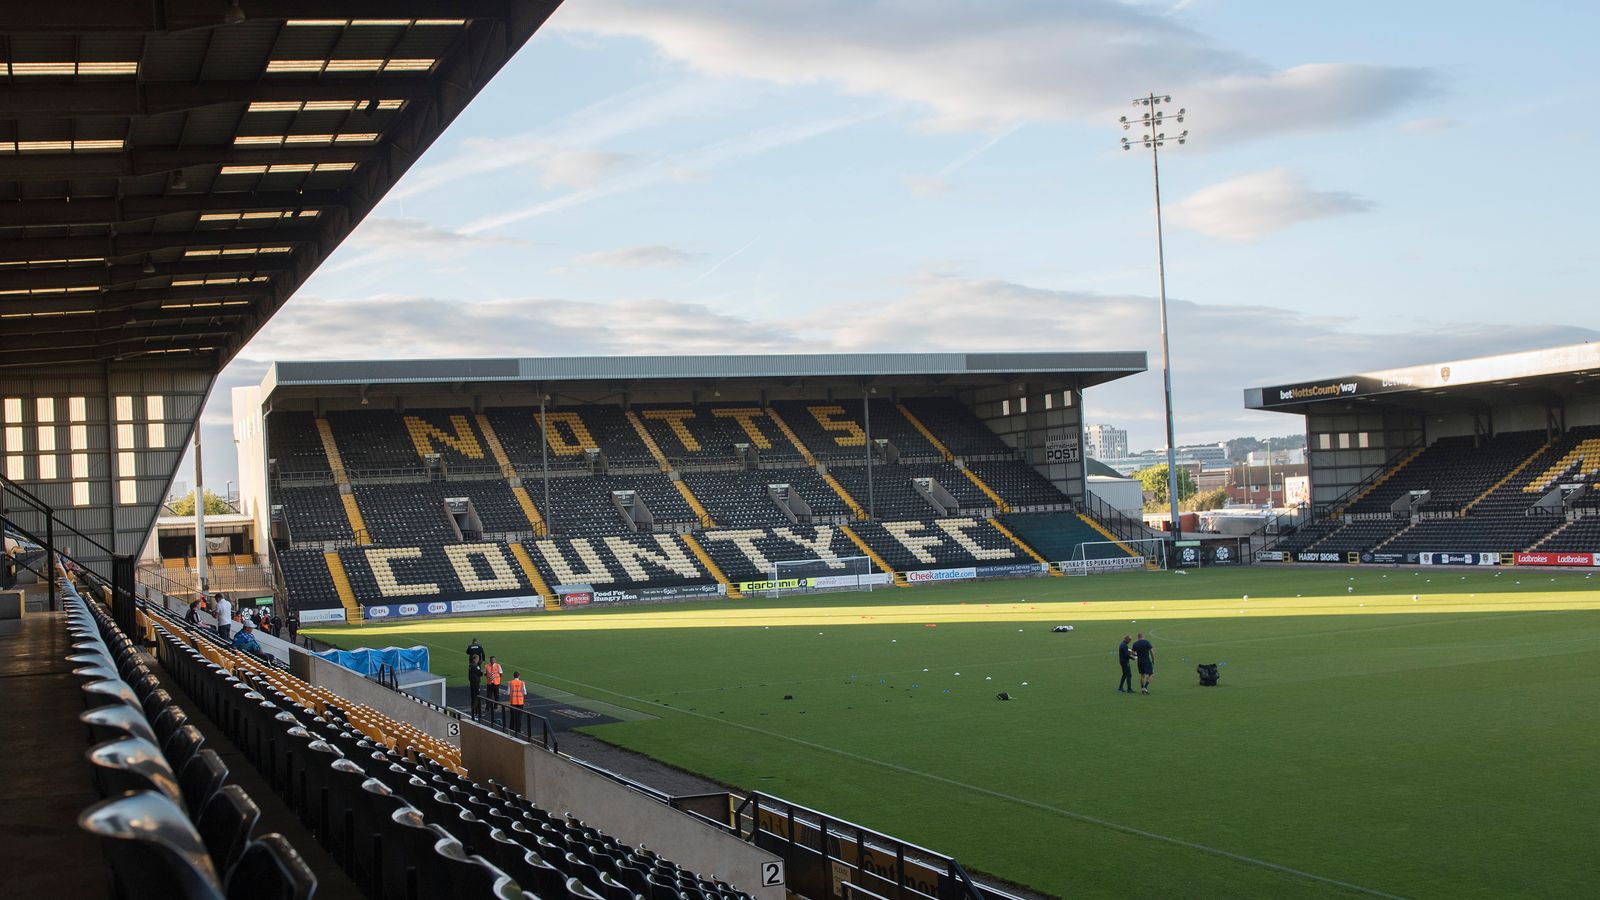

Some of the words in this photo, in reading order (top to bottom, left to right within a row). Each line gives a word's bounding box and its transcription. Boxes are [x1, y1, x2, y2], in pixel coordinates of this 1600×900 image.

[404, 405, 868, 460] NOTTS
[1047, 448, 1078, 460] POST
[881, 517, 1016, 564] FC
[365, 525, 846, 598] COUNTY
[1298, 552, 1319, 561] HARDY
[1320, 553, 1340, 561] SIGNS
[1518, 554, 1548, 563] Ladbrokes
[1557, 555, 1588, 563] Ladbrokes
[909, 570, 975, 581] Checkatrade.com
[450, 723, 459, 735] 3
[766, 863, 780, 884] 2
